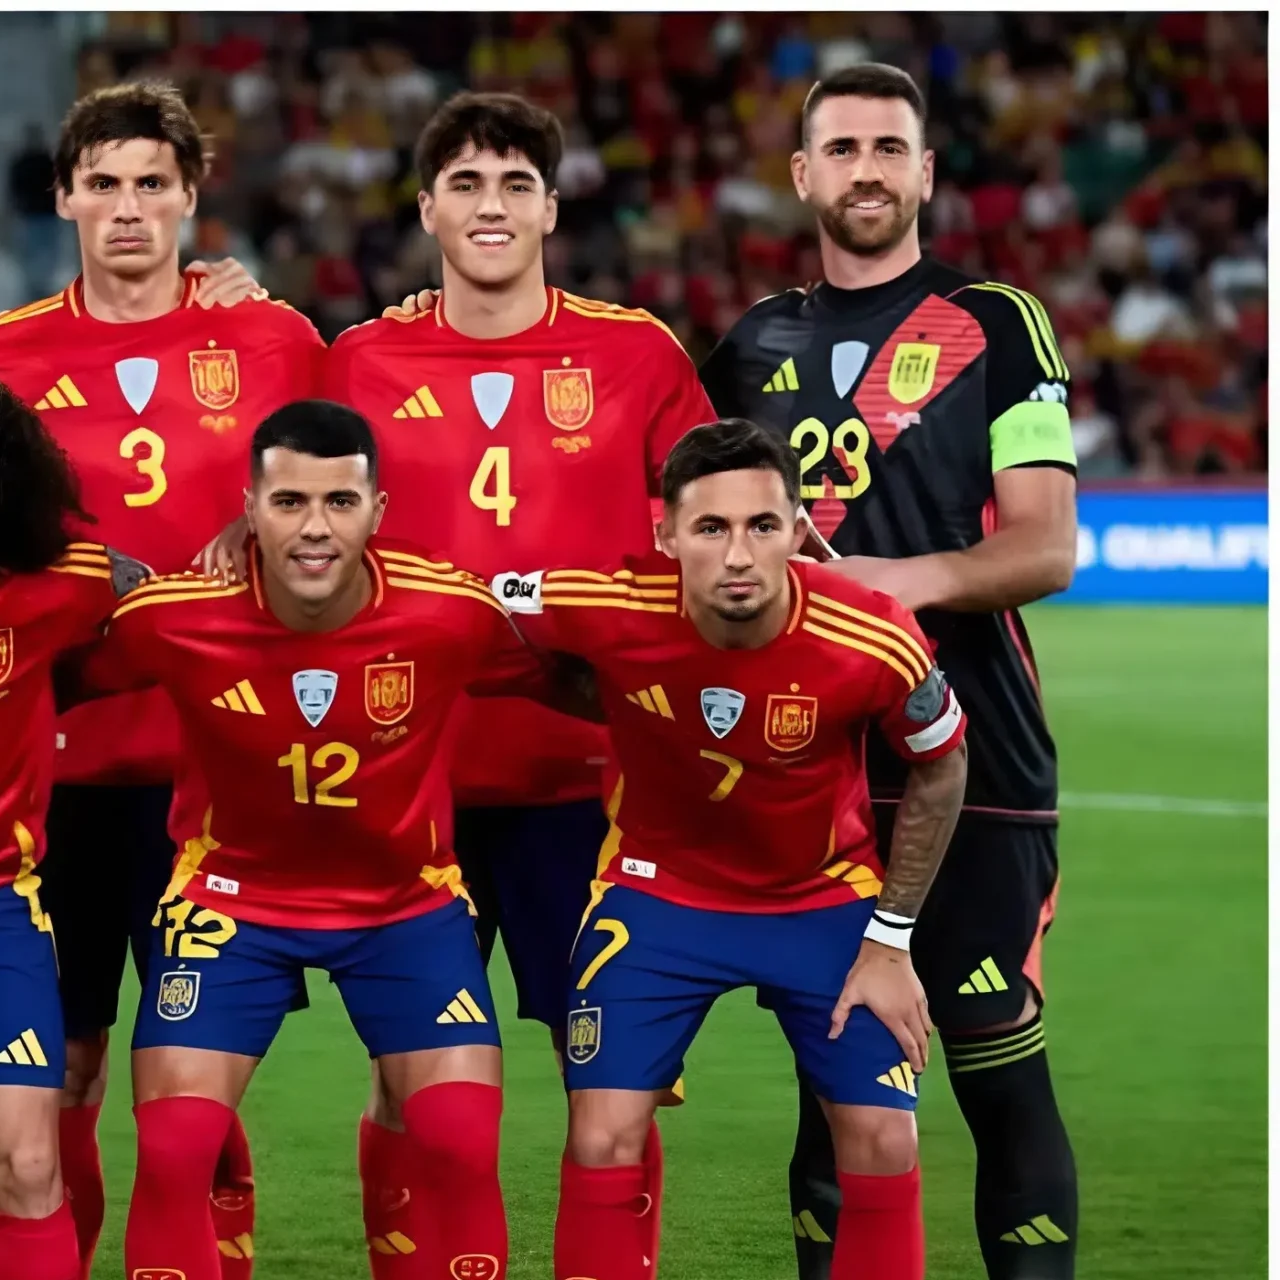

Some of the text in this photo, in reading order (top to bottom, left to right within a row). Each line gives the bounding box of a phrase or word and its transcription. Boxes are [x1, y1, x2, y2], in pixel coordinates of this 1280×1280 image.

[120, 427, 167, 507] 3
[469, 447, 517, 526] 4
[277, 742, 359, 808] 12
[699, 748, 744, 801] 7
[151, 899, 238, 959] 12
[577, 918, 630, 990] 7
